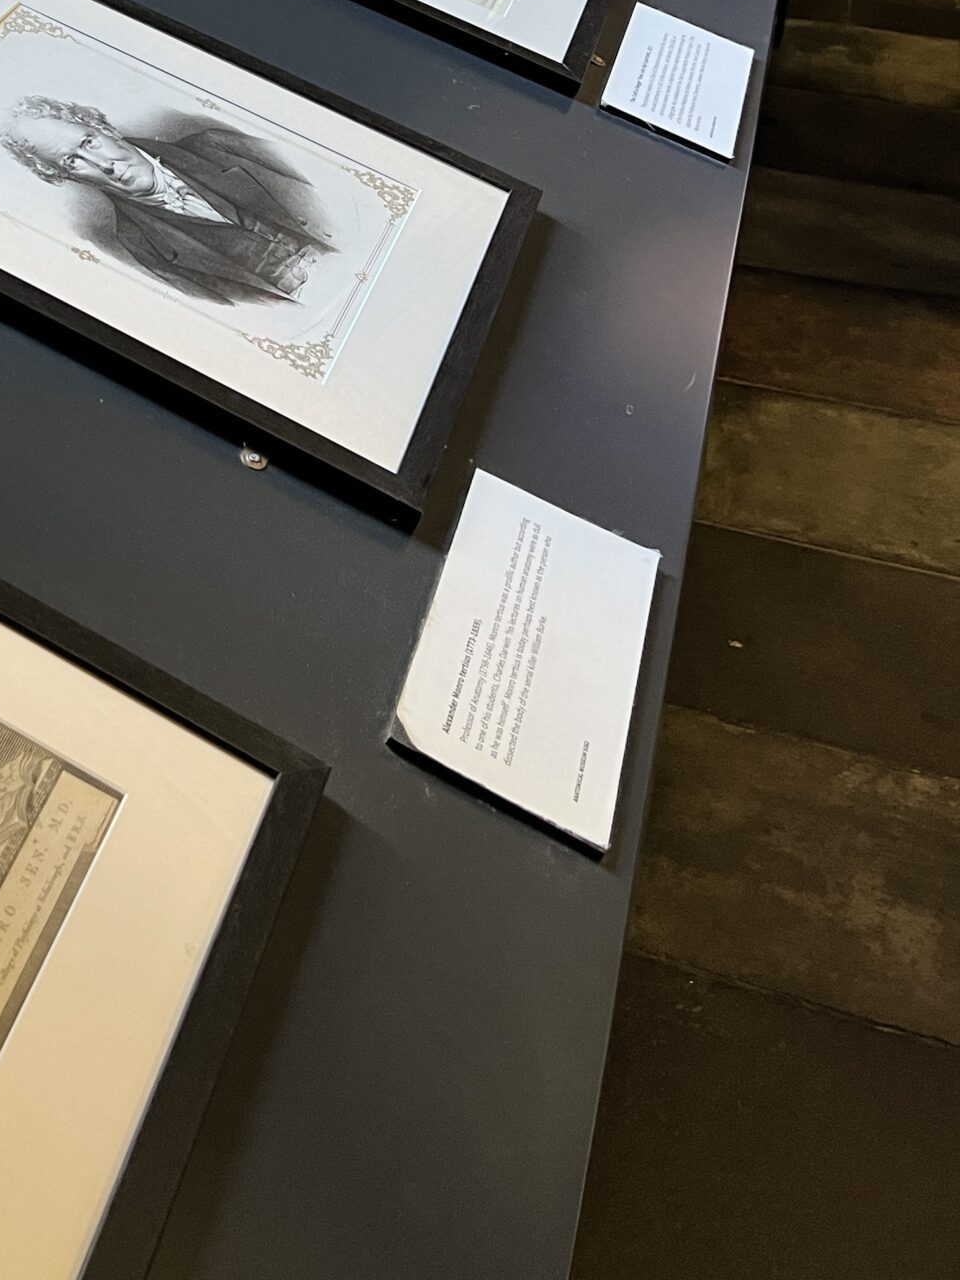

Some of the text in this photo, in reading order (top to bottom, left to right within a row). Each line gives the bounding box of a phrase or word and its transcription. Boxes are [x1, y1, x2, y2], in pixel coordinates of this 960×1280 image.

[516, 516, 530, 543] according
[513, 541, 522, 552] but
[529, 540, 537, 554] were
[508, 551, 520, 570] author
[521, 552, 535, 577] anatomy
[541, 547, 551, 567] person
[536, 564, 544, 575] the
[516, 575, 527, 595] human
[529, 580, 540, 600] known
[507, 601, 520, 625] lectures
[526, 599, 535, 613] best
[488, 621, 500, 641] Monro
[520, 612, 534, 637] perhaps
[492, 658, 505, 682] Charles
[527, 654, 537, 670] killer
[441, 697, 458, 734] Alexander
[451, 676, 464, 699] Monro
[458, 654, 471, 677] tertius
[470, 675, 486, 706] Anatomy
[484, 680, 501, 712] students,
[503, 677, 515, 700] Monro
[519, 686, 529, 699] the
[518, 696, 526, 706] of
[481, 710, 491, 722] his
[513, 705, 526, 724] body
[459, 710, 475, 743] Professor
[479, 719, 488, 730] of
[495, 726, 503, 740] was
[510, 721, 520, 734] the
[478, 729, 486, 743] one
[490, 738, 499, 750] he
[473, 741, 482, 751] to
[502, 733, 517, 766] dissected
